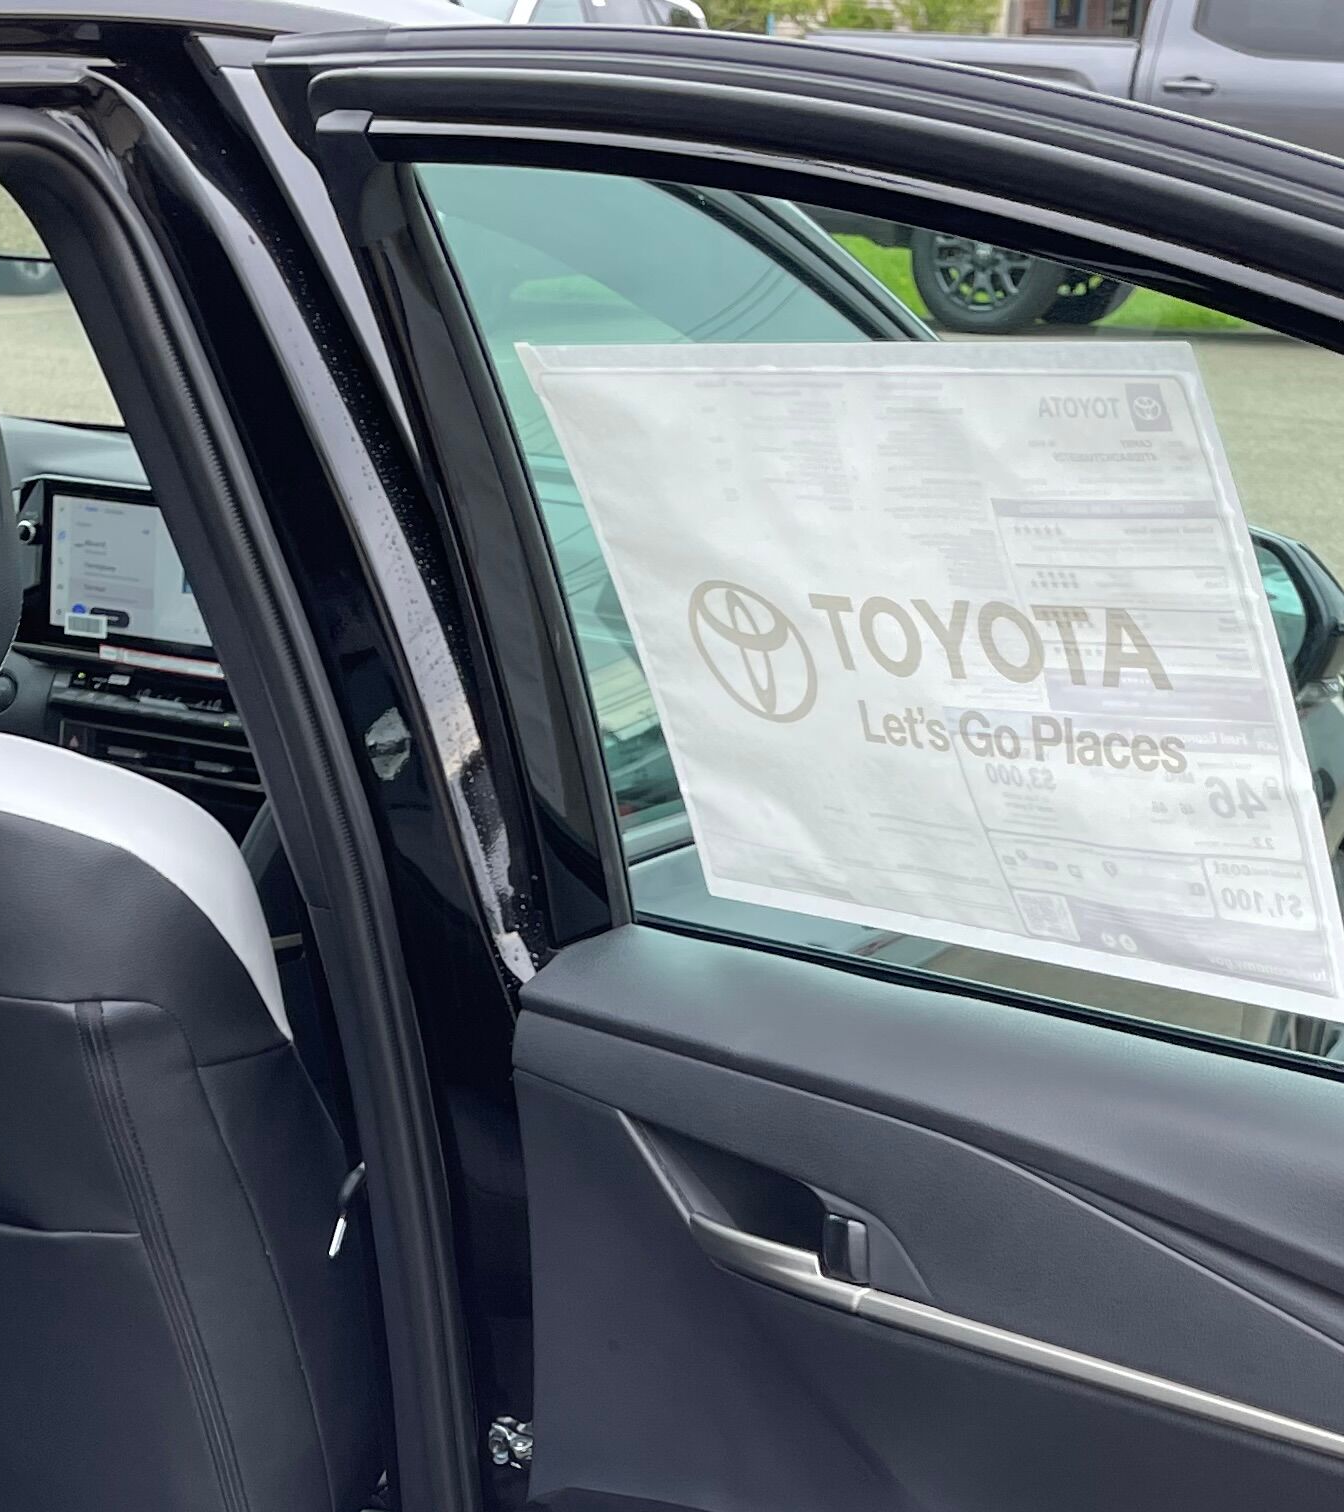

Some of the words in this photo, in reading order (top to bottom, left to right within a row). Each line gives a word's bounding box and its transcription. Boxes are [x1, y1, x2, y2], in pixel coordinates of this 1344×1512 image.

[809, 593, 1174, 692] TOYOTA
[858, 700, 951, 754] Let's
[960, 711, 1021, 761] Go
[1032, 714, 1188, 775] Places
